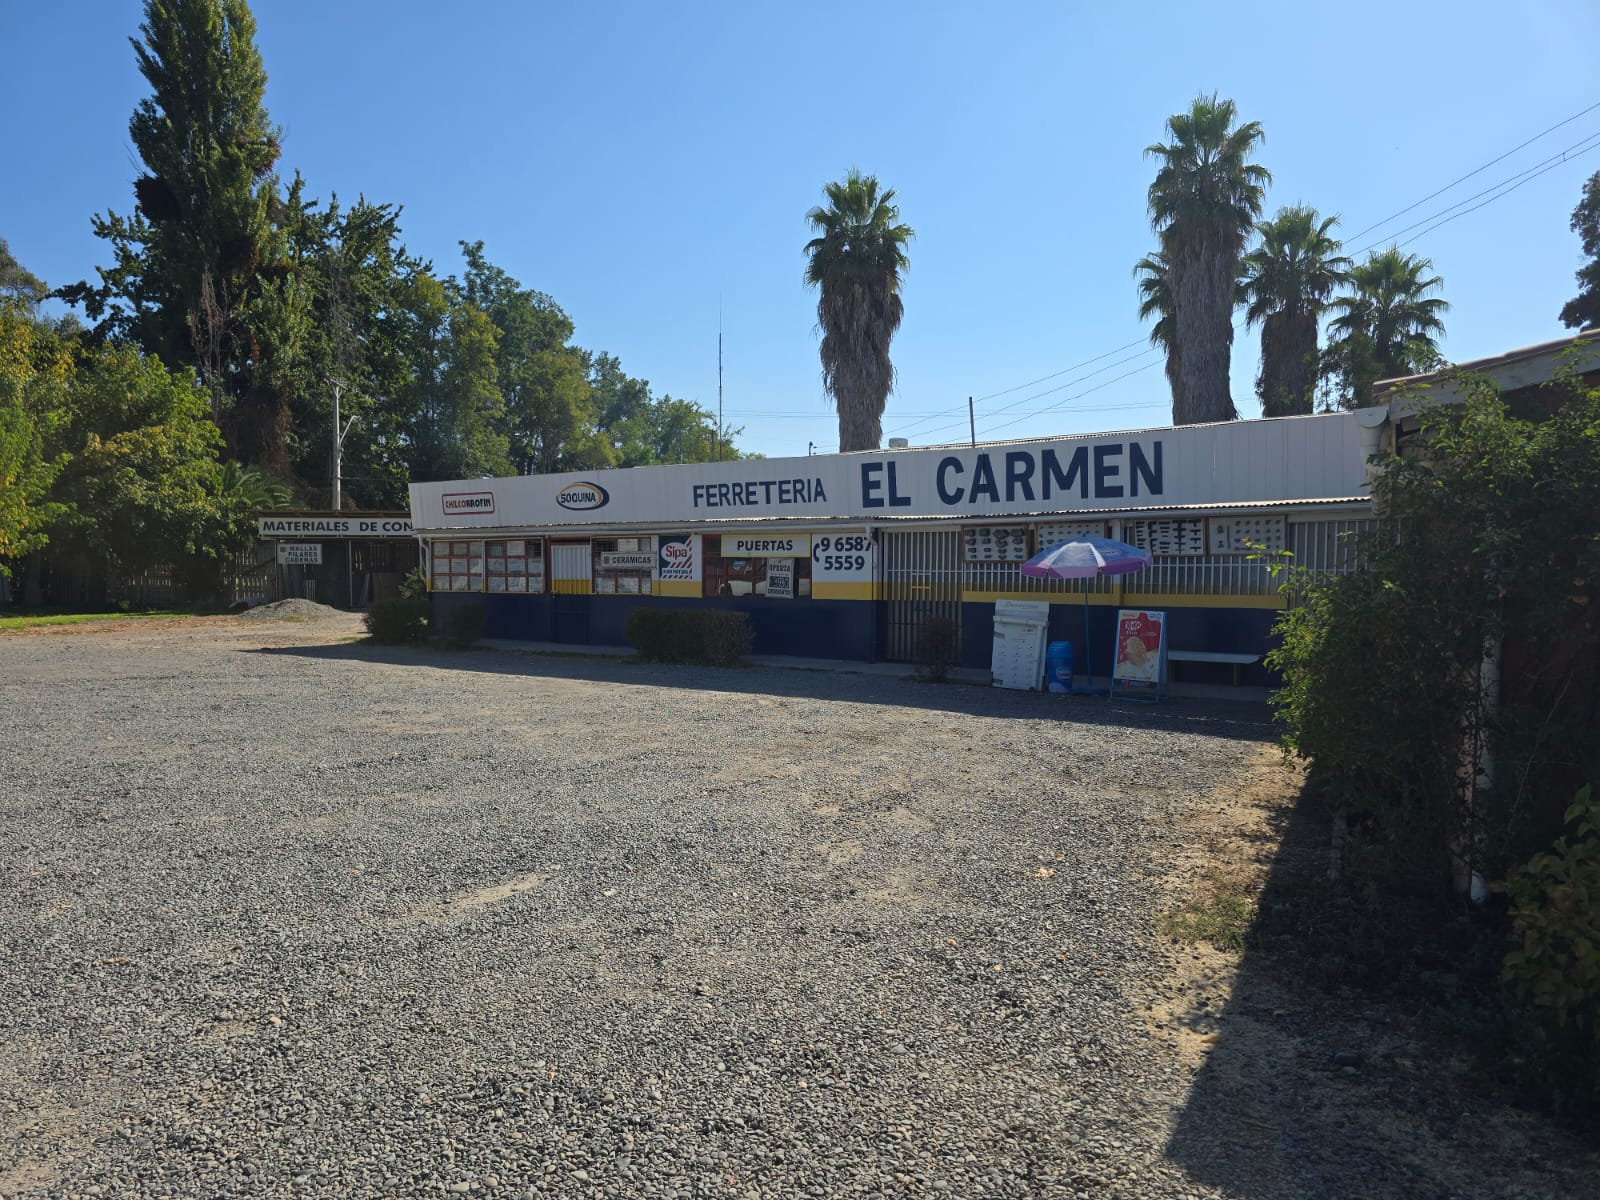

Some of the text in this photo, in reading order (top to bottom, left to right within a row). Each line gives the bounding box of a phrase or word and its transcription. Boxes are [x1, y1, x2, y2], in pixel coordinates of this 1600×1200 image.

[693, 441, 1164, 508] FERRETERIA EL CARMEN
[560, 491, 597, 504] SOQUINA
[263, 521, 349, 533] MATERIALES
[360, 521, 378, 532] DE
[737, 539, 793, 552] PUERTAS
[820, 536, 830, 552] 9
[665, 545, 688, 560] Sipa
[612, 556, 652, 564] CERAMICAS
[823, 555, 865, 571] 5559
